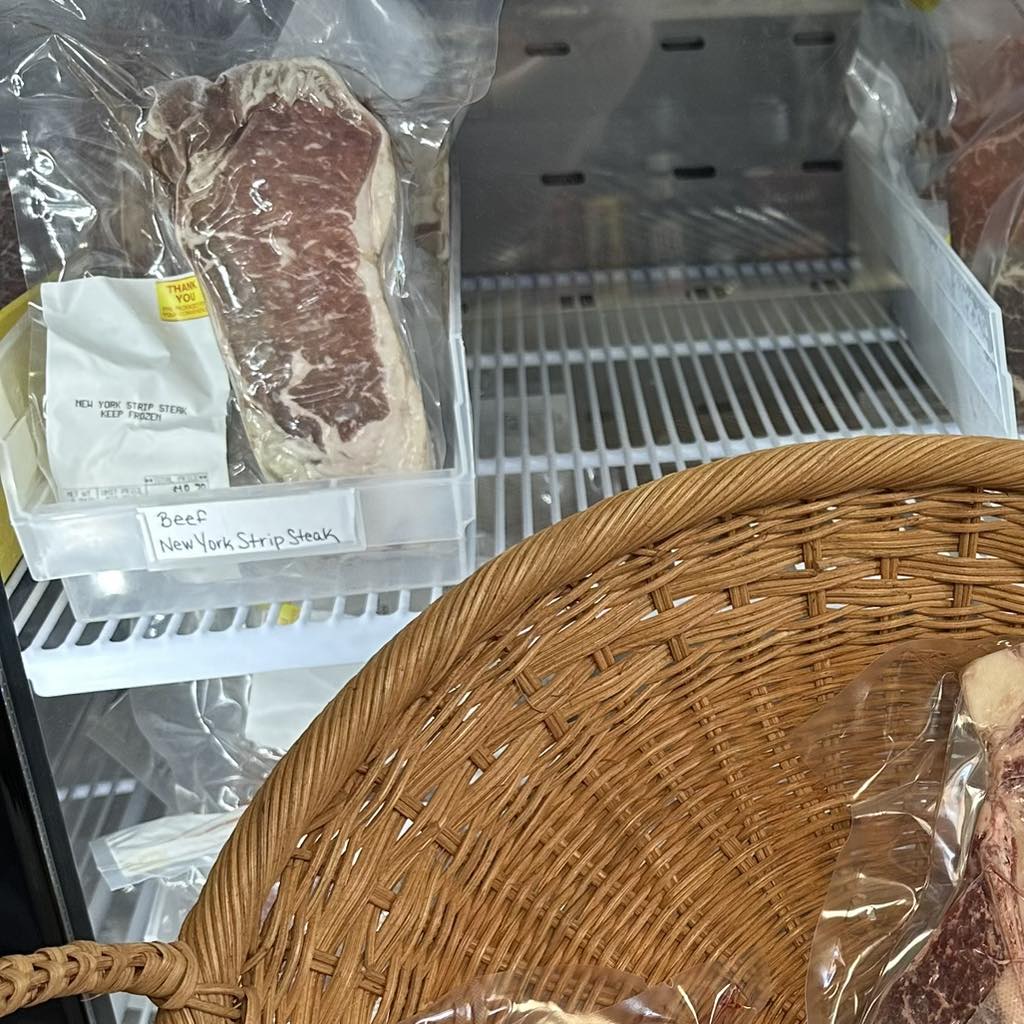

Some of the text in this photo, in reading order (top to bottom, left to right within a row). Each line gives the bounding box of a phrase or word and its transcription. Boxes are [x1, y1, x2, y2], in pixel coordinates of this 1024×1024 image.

[167, 281, 197, 293] THANK
[175, 292, 196, 303] YOU
[75, 400, 187, 415] NEW YORK STRIP STEAK
[100, 410, 161, 421] KEEP FROZEN
[157, 509, 207, 528] Beef
[159, 527, 341, 553] New York Strip Steak
